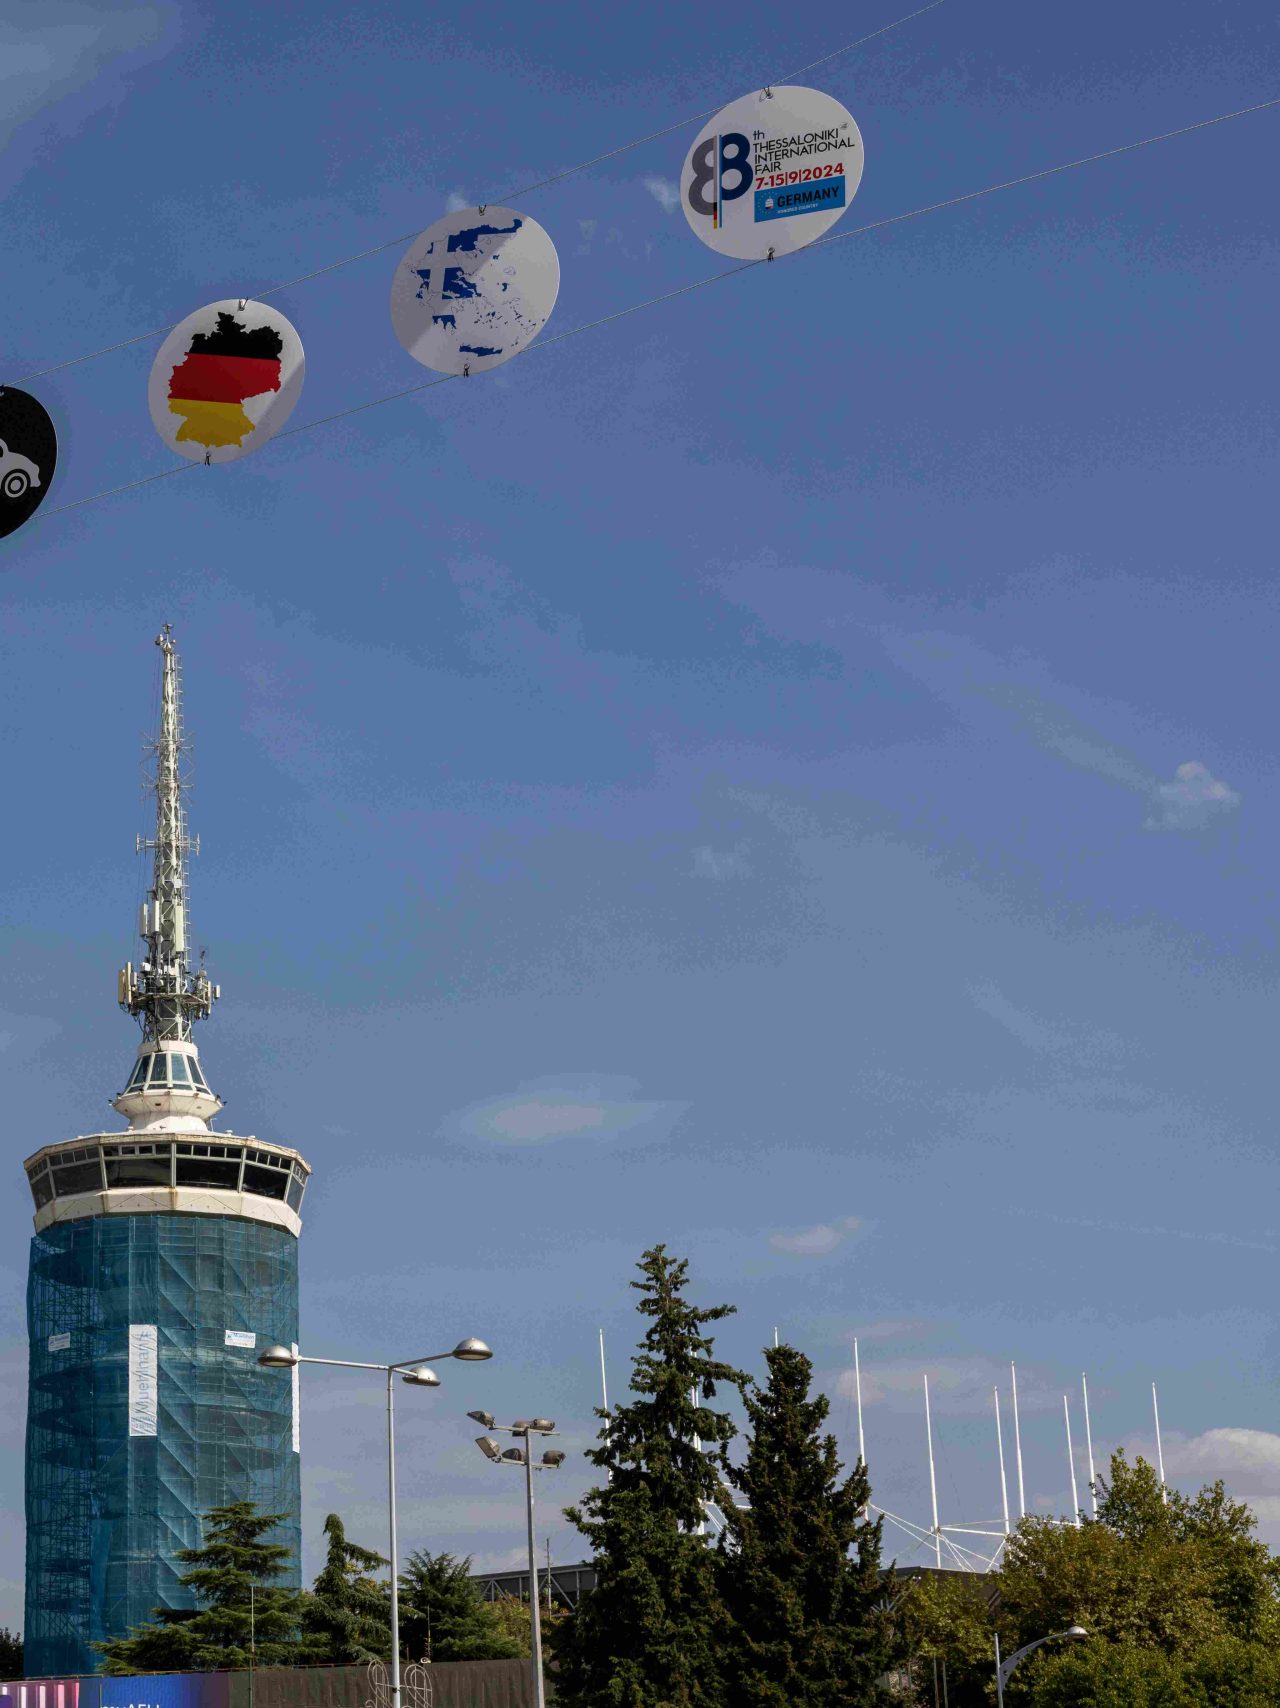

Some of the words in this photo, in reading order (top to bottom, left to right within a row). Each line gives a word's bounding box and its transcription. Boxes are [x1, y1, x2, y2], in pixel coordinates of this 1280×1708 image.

[752, 128, 840, 154] THESSALONIKI
[754, 136, 856, 165] INTERNATIONAL
[688, 132, 754, 216] 88
[753, 129, 765, 141] th
[754, 161, 782, 176] FAIR
[777, 186, 840, 208] GERMANY
